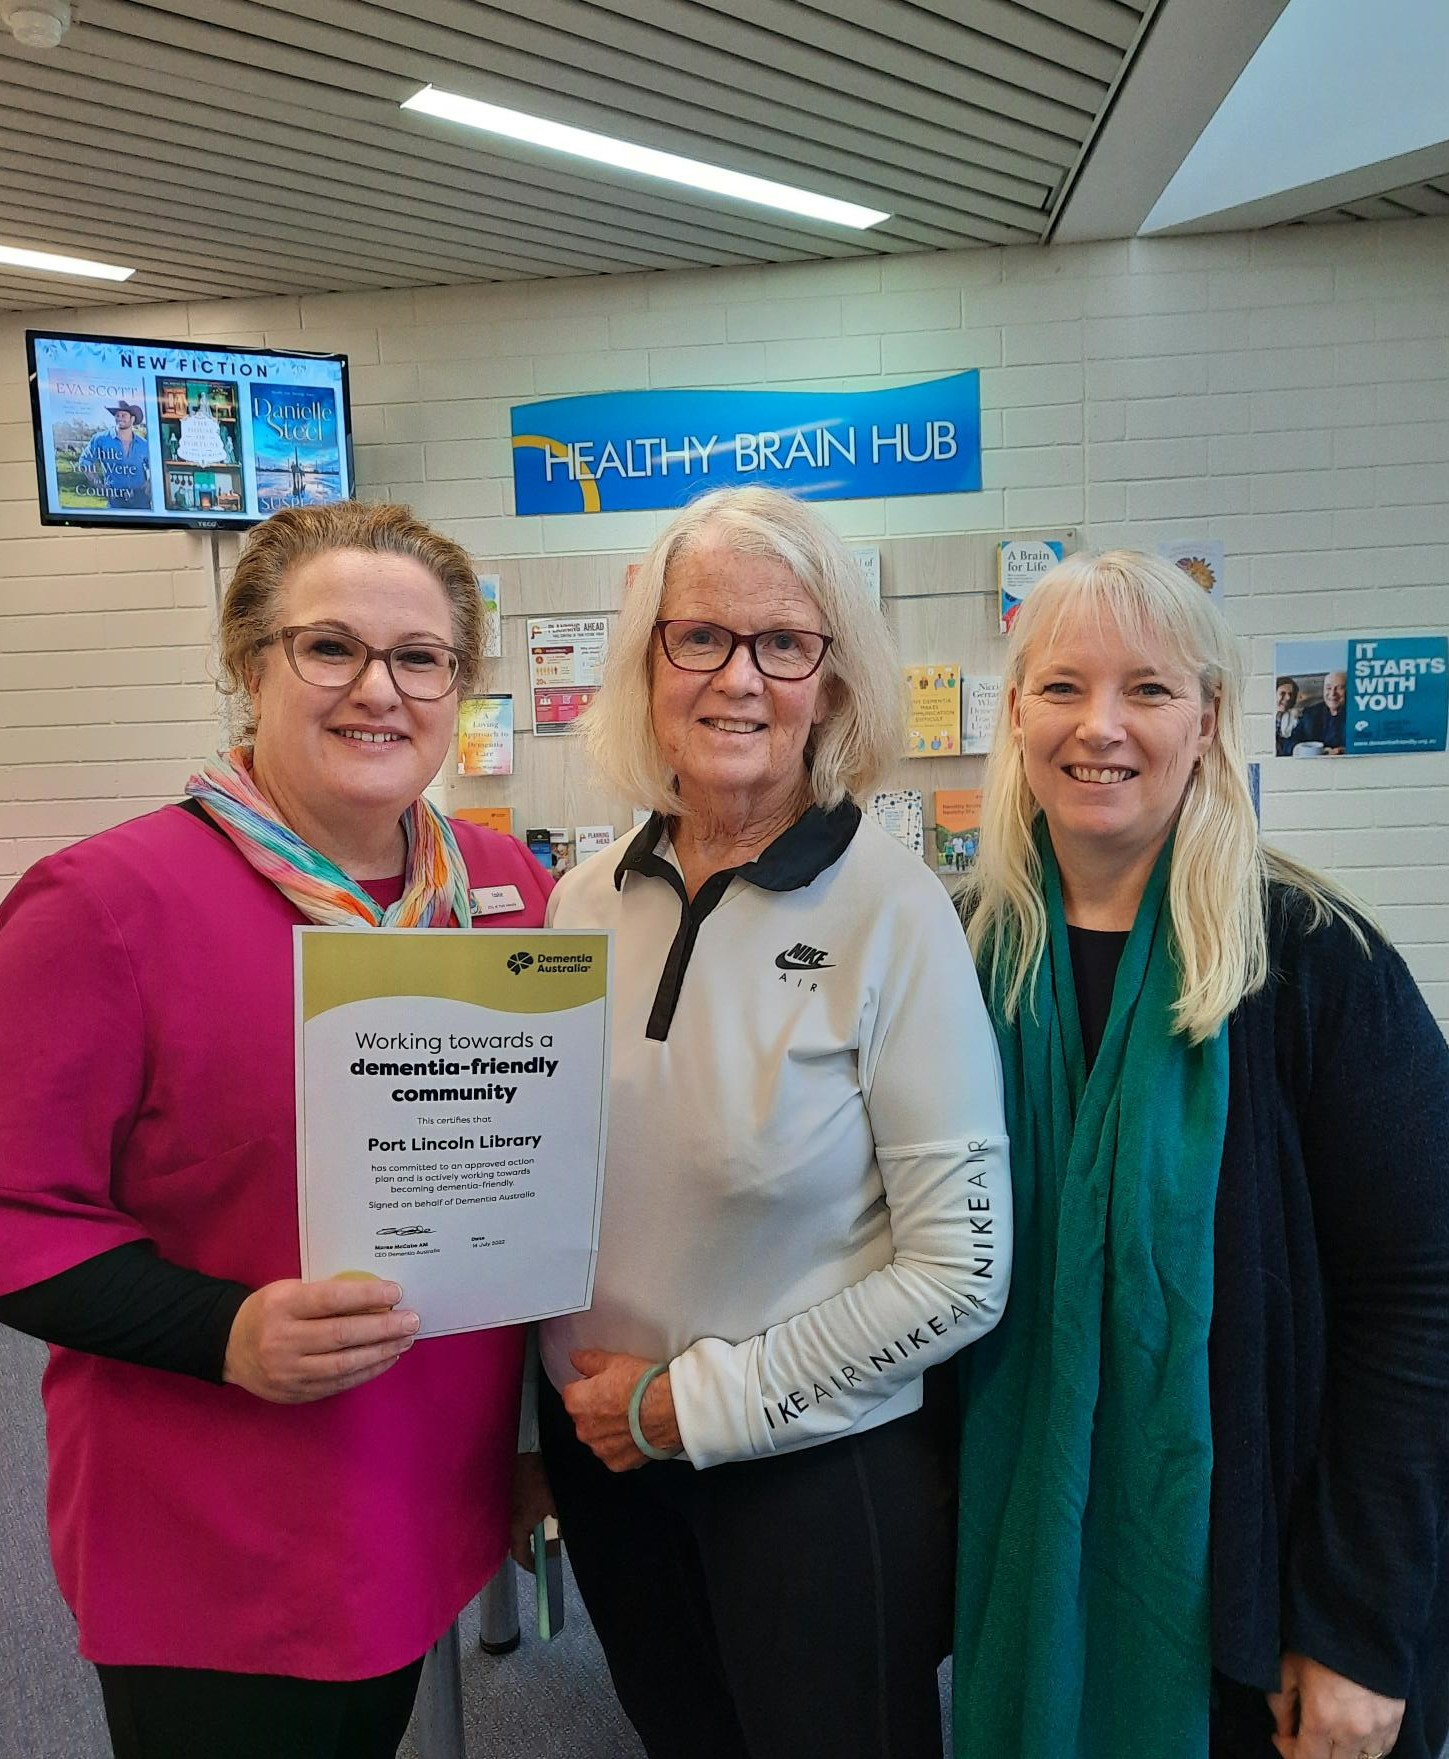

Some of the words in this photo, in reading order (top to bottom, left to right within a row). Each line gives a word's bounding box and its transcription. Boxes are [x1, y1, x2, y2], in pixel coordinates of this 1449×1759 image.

[121, 354, 167, 370] NEW
[179, 359, 267, 377] FICTION
[56, 383, 84, 395] EVA
[88, 384, 138, 397] SCOTT
[254, 397, 332, 421] Danielle
[267, 415, 323, 441] Steel
[81, 447, 123, 460] While
[545, 434, 718, 482] HEALTHY
[734, 427, 856, 472] BRAIN
[871, 420, 958, 464] HUB
[69, 460, 97, 473] You
[101, 462, 137, 475] Were
[75, 484, 134, 501] Country
[1008, 550, 1016, 560] A
[1020, 550, 1050, 560] Brain
[1008, 561, 1023, 572] for
[1026, 561, 1047, 572] Life
[583, 622, 604, 631] AHEAD
[1355, 643, 1378, 659] IT
[1354, 657, 1446, 677] STARTS
[1354, 676, 1416, 694] WITH
[1354, 693, 1404, 711] YOU
[537, 953, 593, 963] Dementia
[787, 942, 828, 966] NIKE
[778, 972, 818, 992] AIR
[355, 1032, 442, 1054] Working
[449, 1032, 534, 1049] towards
[540, 1035, 554, 1048] a
[350, 1056, 559, 1078] dementia-friendly
[391, 1083, 518, 1104] community
[417, 1117, 434, 1125] This
[436, 1116, 471, 1124] certifies
[473, 1116, 492, 1124] that
[368, 1138, 406, 1151] Port
[411, 1136, 474, 1151] Lincoln
[480, 1135, 542, 1149] Library
[371, 1164, 387, 1172] has
[388, 1163, 437, 1171] committed
[464, 1160, 506, 1170] approved
[507, 1158, 535, 1166] action
[375, 1175, 395, 1184] plan
[396, 1175, 415, 1183] and
[425, 1173, 458, 1182] actively
[460, 1171, 494, 1179] working
[496, 1168, 531, 1177] towards
[436, 1179, 514, 1191] dementia-friendly.
[368, 1201, 399, 1210] Signed
[415, 1199, 443, 1207] behalf
[444, 1198, 454, 1206] of
[455, 1196, 497, 1205] Dementia
[499, 1191, 536, 1200] Australia
